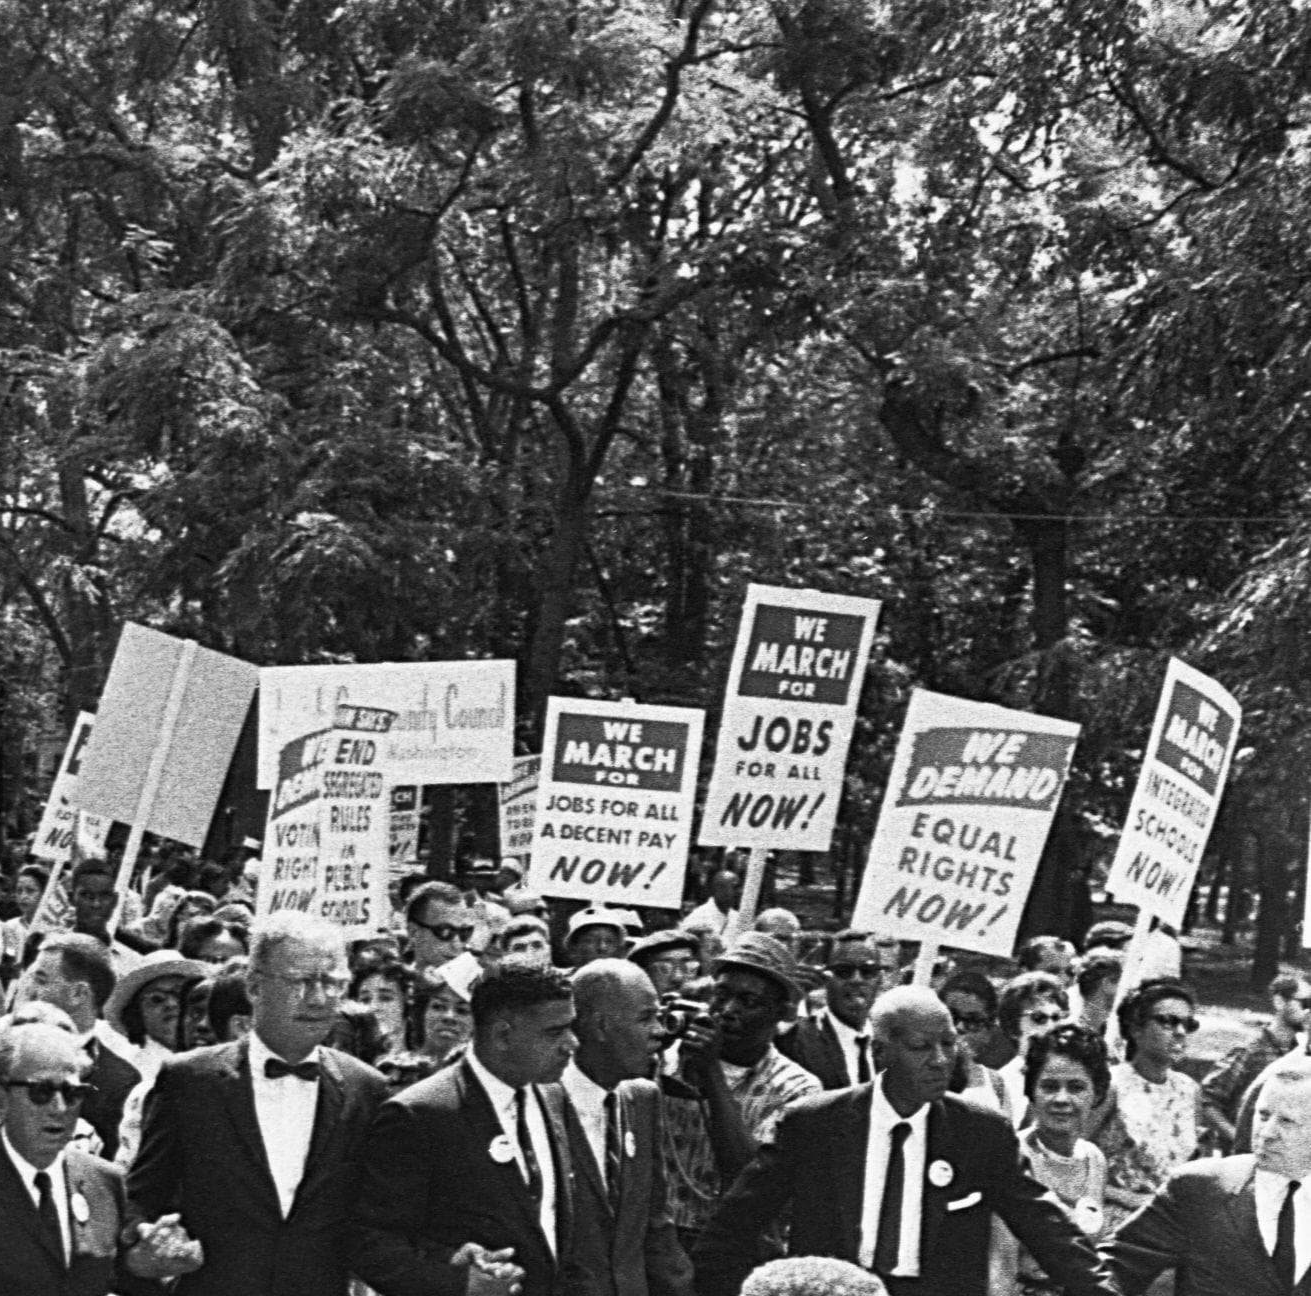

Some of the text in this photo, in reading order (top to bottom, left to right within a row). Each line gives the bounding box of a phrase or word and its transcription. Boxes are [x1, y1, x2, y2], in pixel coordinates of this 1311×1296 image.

[794, 615, 829, 642] WE
[750, 641, 851, 680] MARCH
[777, 680, 816, 698] FOR
[602, 722, 643, 743] WE
[737, 715, 834, 756] JOBS
[961, 732, 1028, 764] WE
[1164, 714, 1225, 774] MARCH
[335, 738, 376, 766] END
[562, 740, 677, 774] MARCH
[594, 770, 640, 786] FOR
[735, 761, 822, 781] FOR ALL
[907, 766, 1060, 801] DEMAND
[545, 795, 679, 822] JOBS FOR ALL
[720, 792, 826, 831] NOW!
[1144, 769, 1211, 830] INTEGRATED
[276, 821, 320, 848] VOTIN
[330, 804, 372, 833] RULES
[44, 827, 74, 849] NO
[540, 823, 677, 850] A DECENT PAY
[910, 812, 1017, 862] EQUAL
[1135, 808, 1198, 864] SCHOOLS
[325, 862, 372, 893] PUBLIC
[549, 855, 668, 890] NOW!
[898, 846, 1014, 896] RIGHTS
[1126, 851, 1187, 903] NOW!
[883, 886, 1009, 937] NOW!
